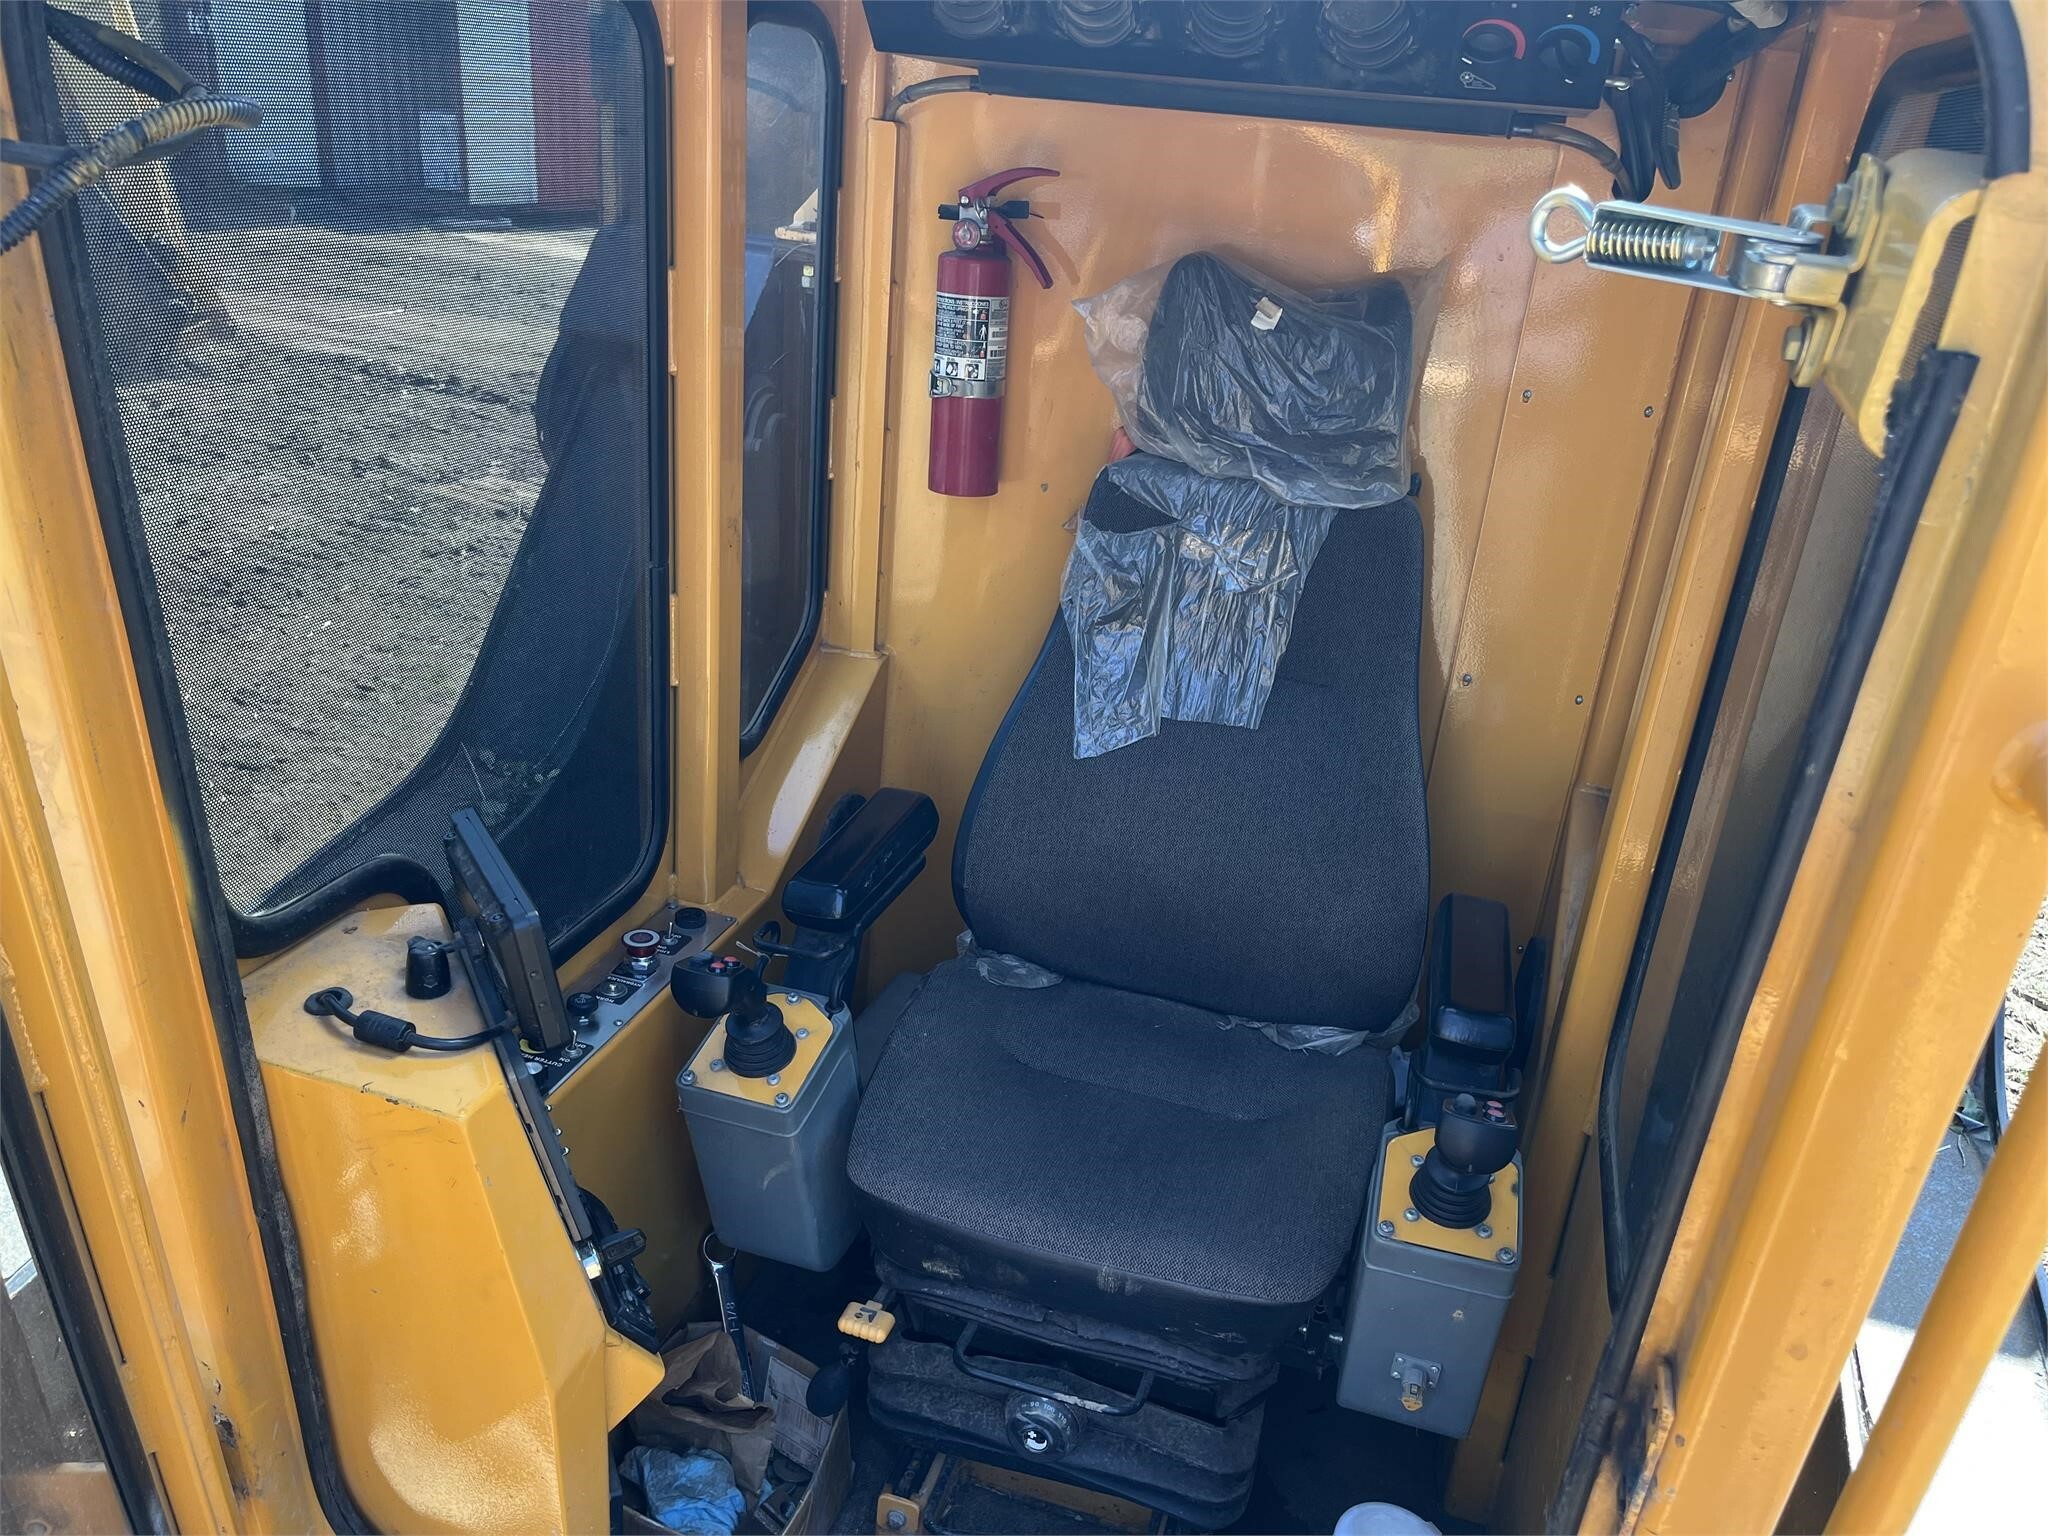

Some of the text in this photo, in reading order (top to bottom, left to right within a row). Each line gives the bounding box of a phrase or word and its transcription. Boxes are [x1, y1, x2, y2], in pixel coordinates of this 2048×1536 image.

[607, 976, 641, 987] HYDRAULICS
[534, 1056, 563, 1067] CUTTER
[726, 1301, 740, 1333] 1-1/8
[1043, 1404, 1056, 1413] 100
